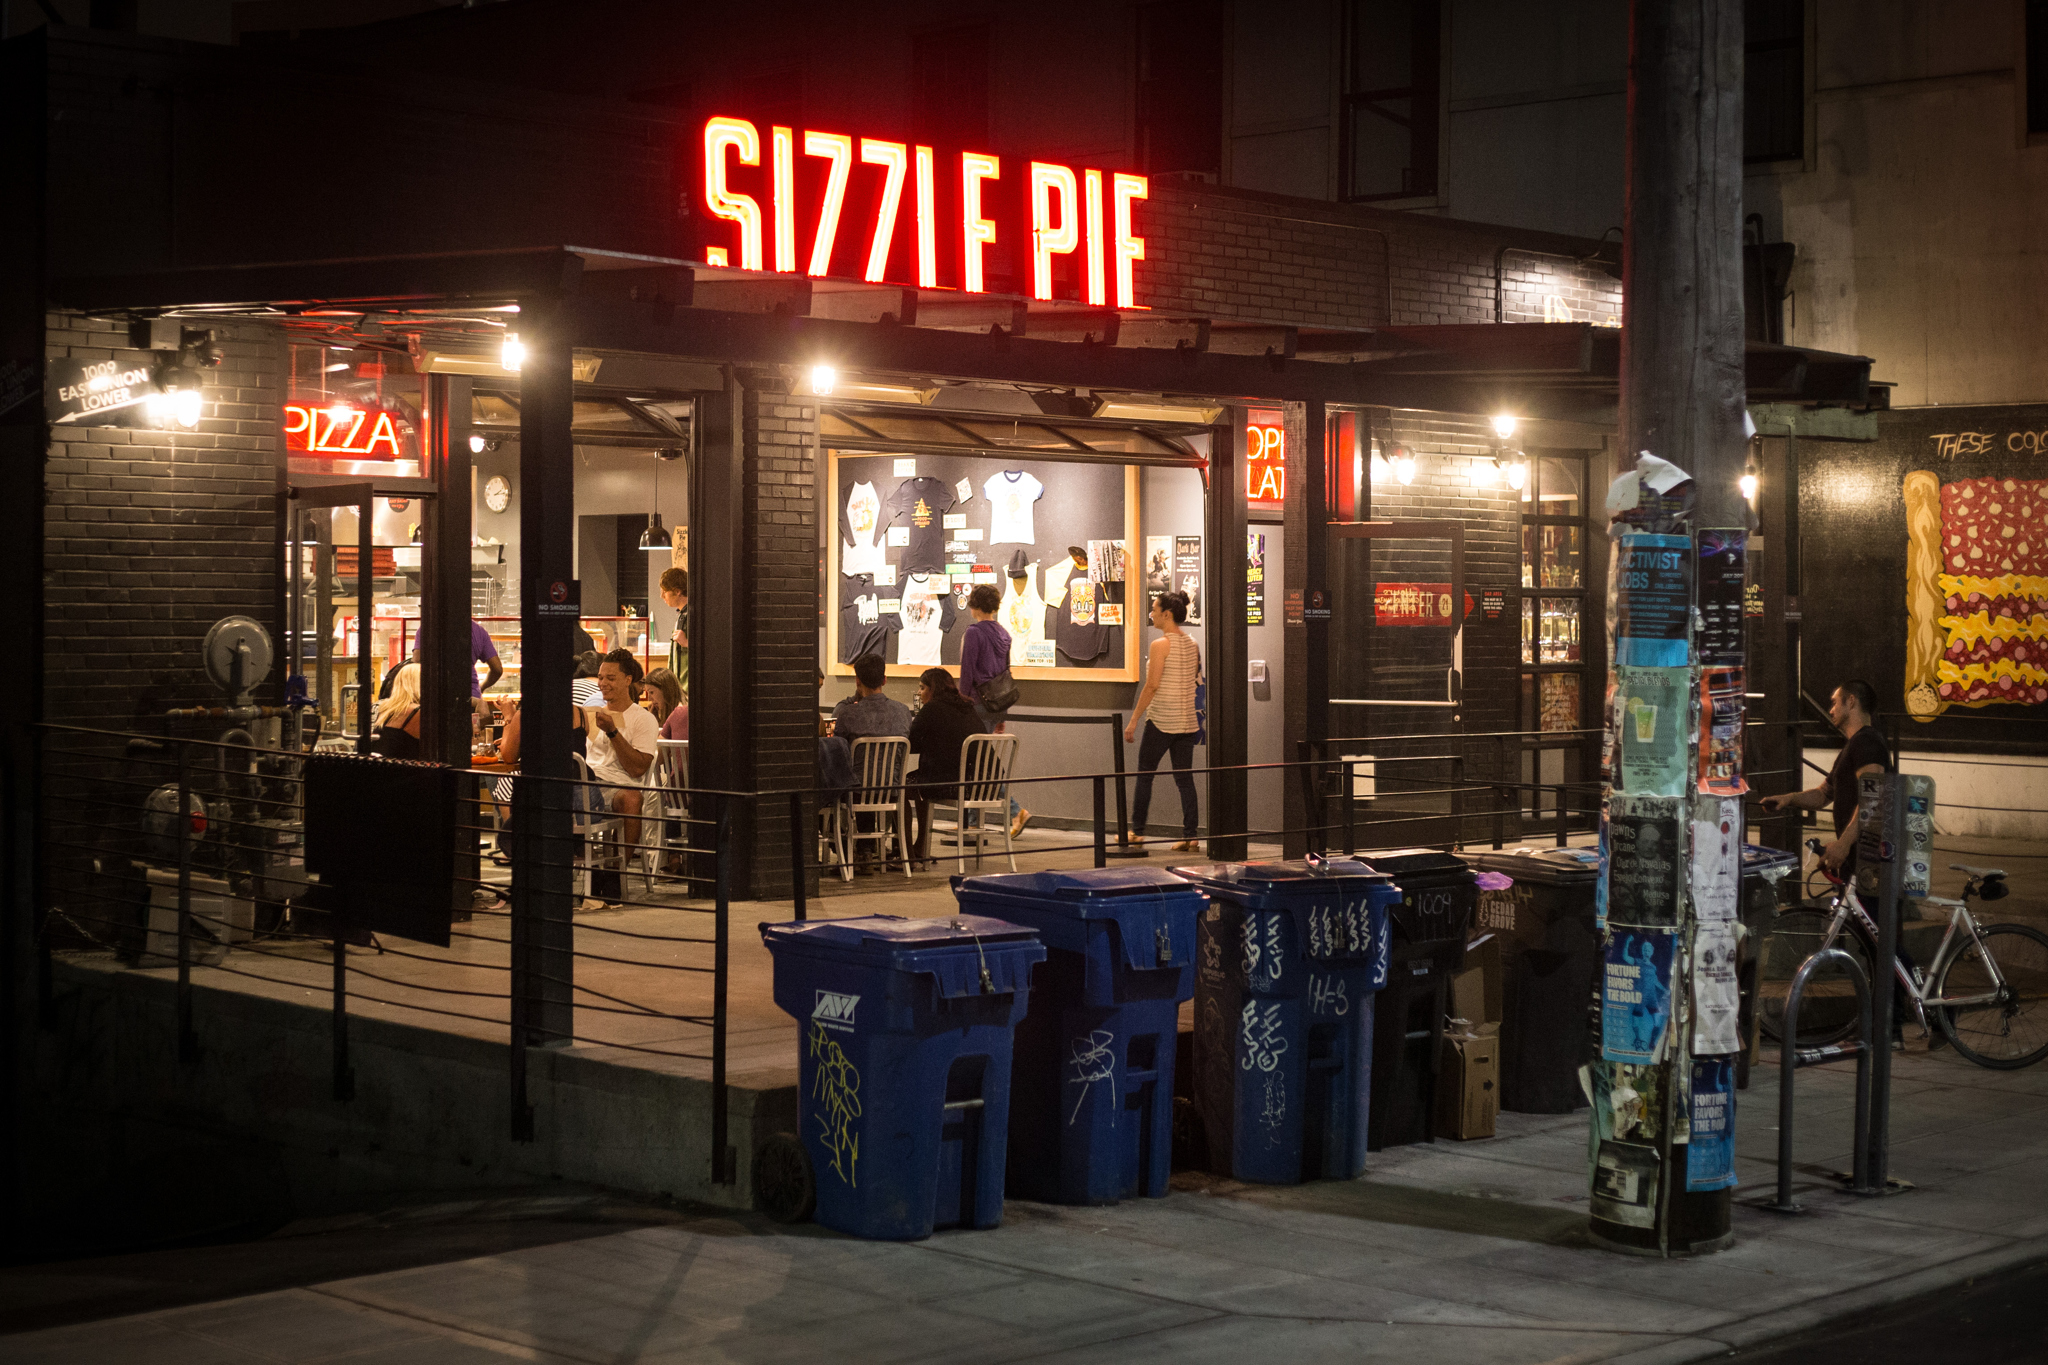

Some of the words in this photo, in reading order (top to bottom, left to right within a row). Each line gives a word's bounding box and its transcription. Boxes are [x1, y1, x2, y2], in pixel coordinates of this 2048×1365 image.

[704, 116, 999, 293] SIZZLE
[1031, 162, 1149, 308] PIE
[82, 360, 117, 380] 1009
[101, 367, 150, 391] UNION
[81, 387, 132, 411] LOWER
[283, 405, 400, 456] PIZZA
[1929, 432, 1997, 462] THESE
[1247, 464, 1285, 499] LAT
[1621, 552, 1682, 570] ACTIVIST
[1620, 572, 1649, 590] JOBS
[1418, 892, 1452, 924] 1009
[1490, 900, 1516, 917] CEDAR
[1489, 914, 1516, 931] GROVE
[1606, 963, 1641, 978] FORTUNE
[1607, 975, 1634, 990] FAVORS
[1606, 988, 1619, 1002] THE
[1620, 990, 1643, 1004] BOLD
[1694, 1092, 1728, 1106] FORTUNE
[1694, 1105, 1724, 1119] FAVORS
[1694, 1119, 1710, 1132] THE
